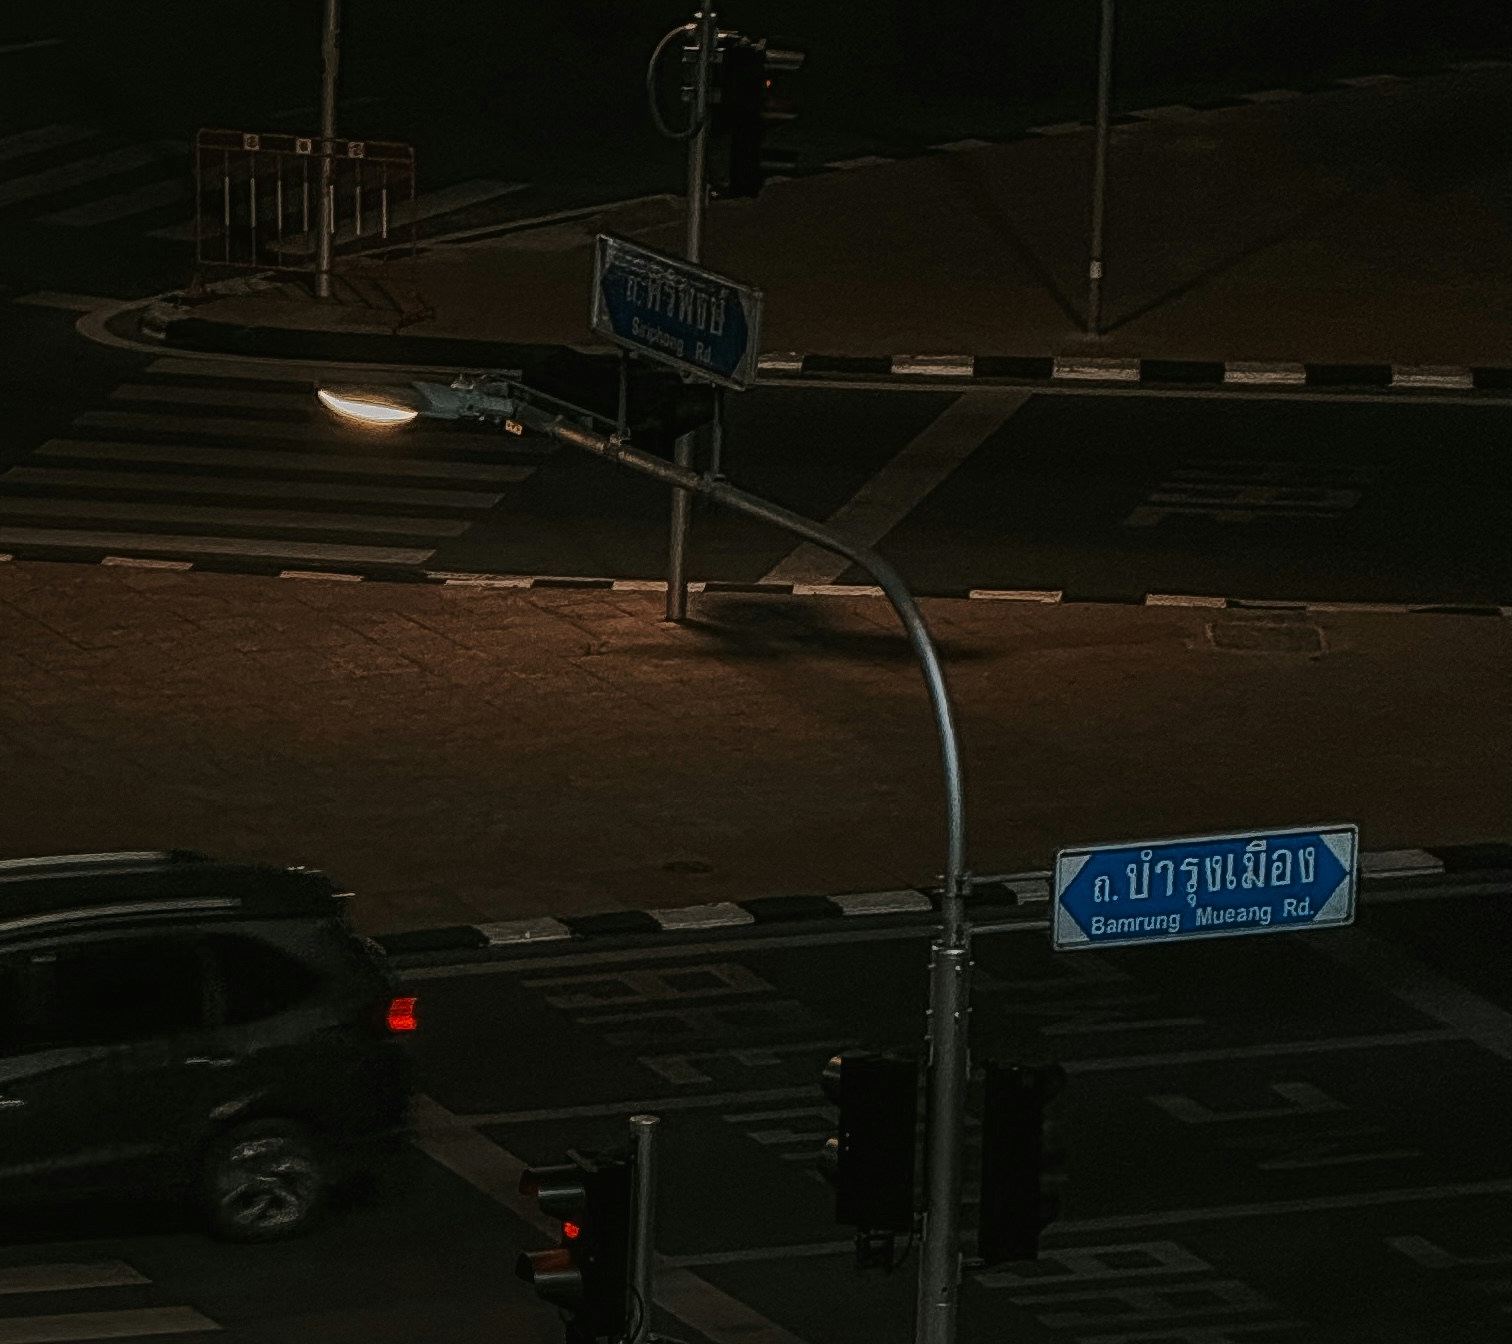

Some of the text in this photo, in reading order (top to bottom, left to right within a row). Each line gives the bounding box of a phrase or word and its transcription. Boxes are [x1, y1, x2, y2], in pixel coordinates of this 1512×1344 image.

[1091, 897, 1315, 935] Bamrung Mueang Rd.
